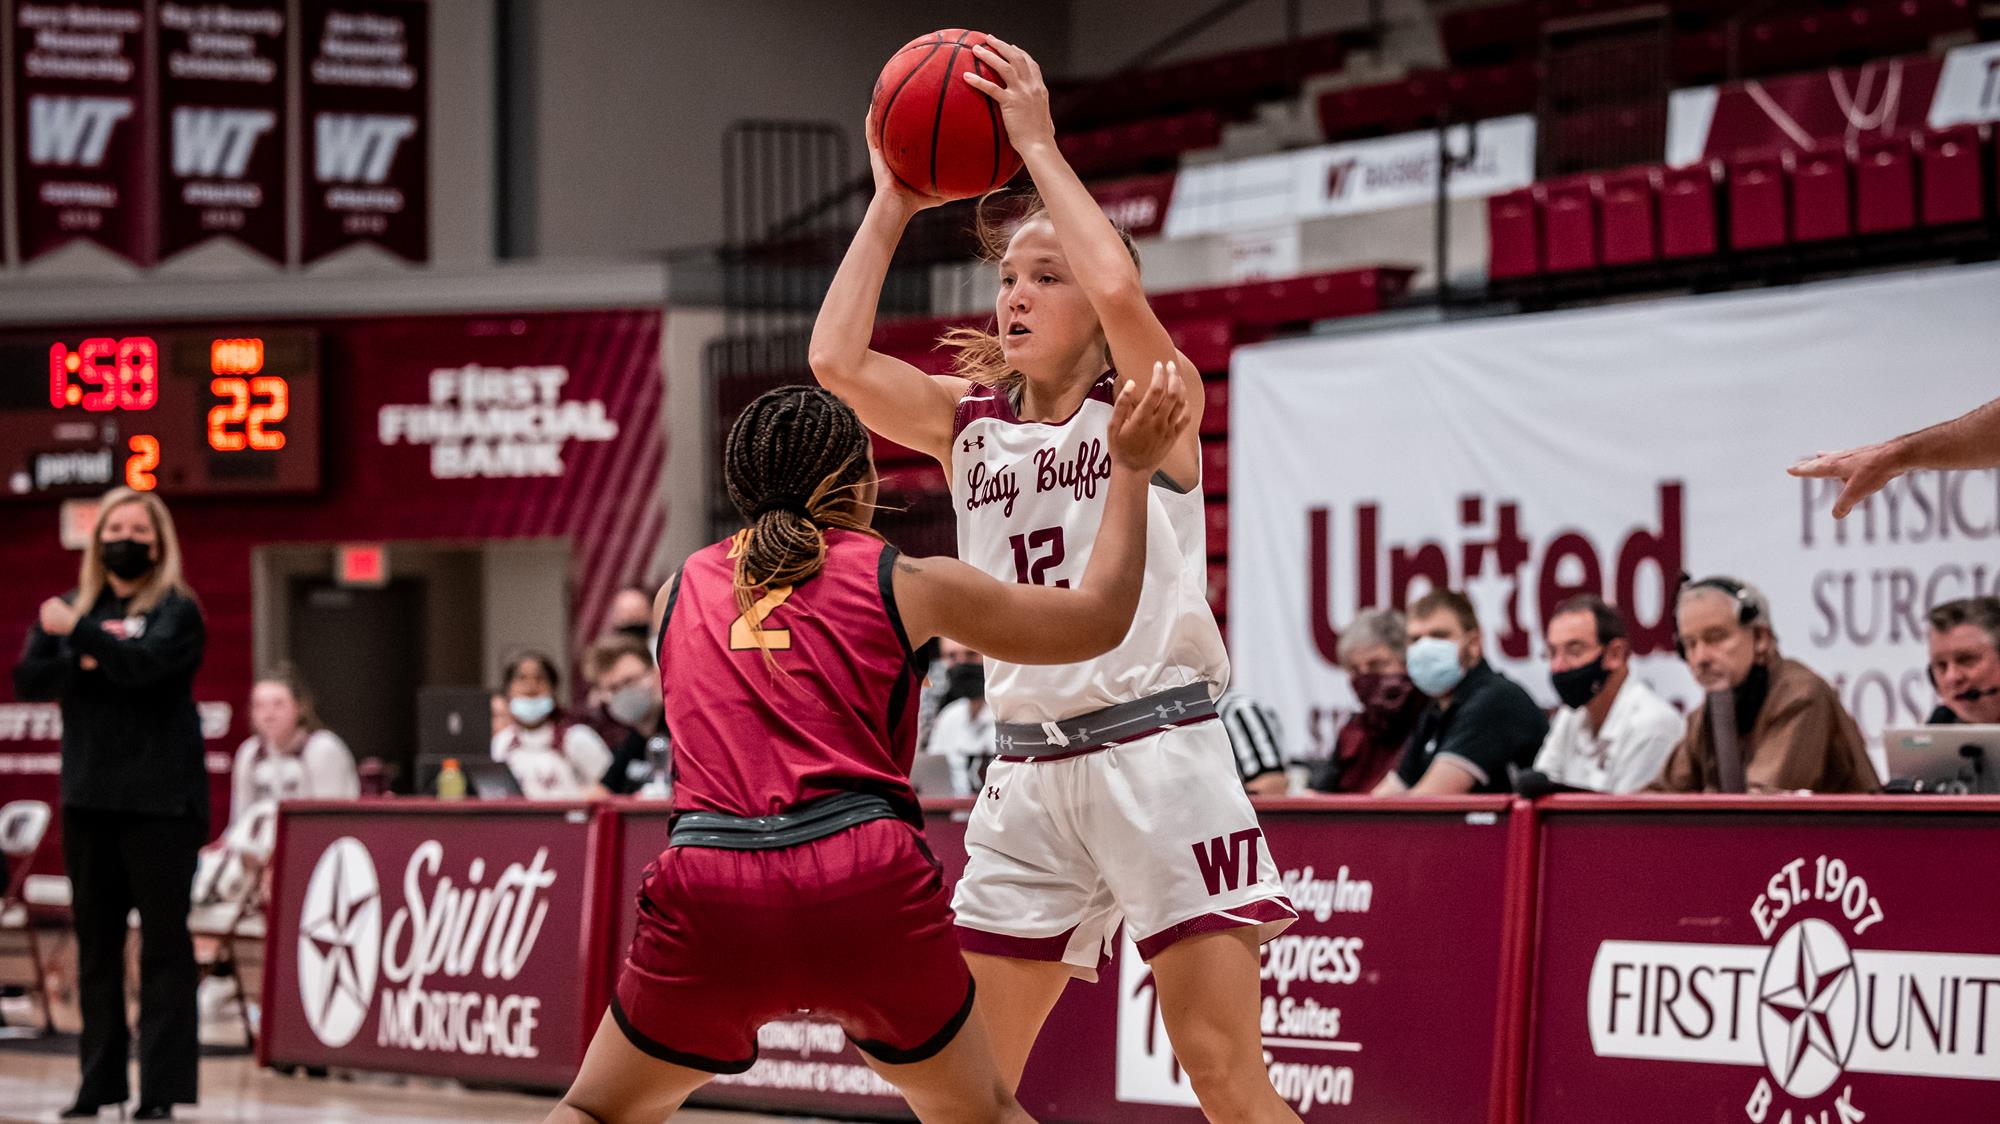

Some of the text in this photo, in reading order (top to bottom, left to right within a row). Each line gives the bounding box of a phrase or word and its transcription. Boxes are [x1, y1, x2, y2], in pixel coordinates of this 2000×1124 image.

[29, 95, 132, 165] WT
[172, 106, 275, 177] WT
[315, 112, 417, 183] WT
[50, 337, 158, 411] 1:58
[429, 364, 569, 405] FIRST
[208, 376, 288, 451] 22
[378, 400, 619, 446] FINANCIAL
[125, 434, 160, 491] 2
[430, 440, 565, 479] BANK
[1009, 526, 1070, 589] 12
[729, 584, 793, 651] 2
[1191, 827, 1262, 896] WT
[1333, 864, 1373, 912] Inn
[382, 840, 557, 995] Spirit
[1750, 854, 1885, 941] EST. 1907
[377, 988, 541, 1058] MORTGAGE
[1277, 997, 1341, 1038] Suites
[1607, 963, 1755, 1041] FIRST
[1866, 973, 2000, 1054] UNIT
[1262, 1050, 1354, 1115] anyon
